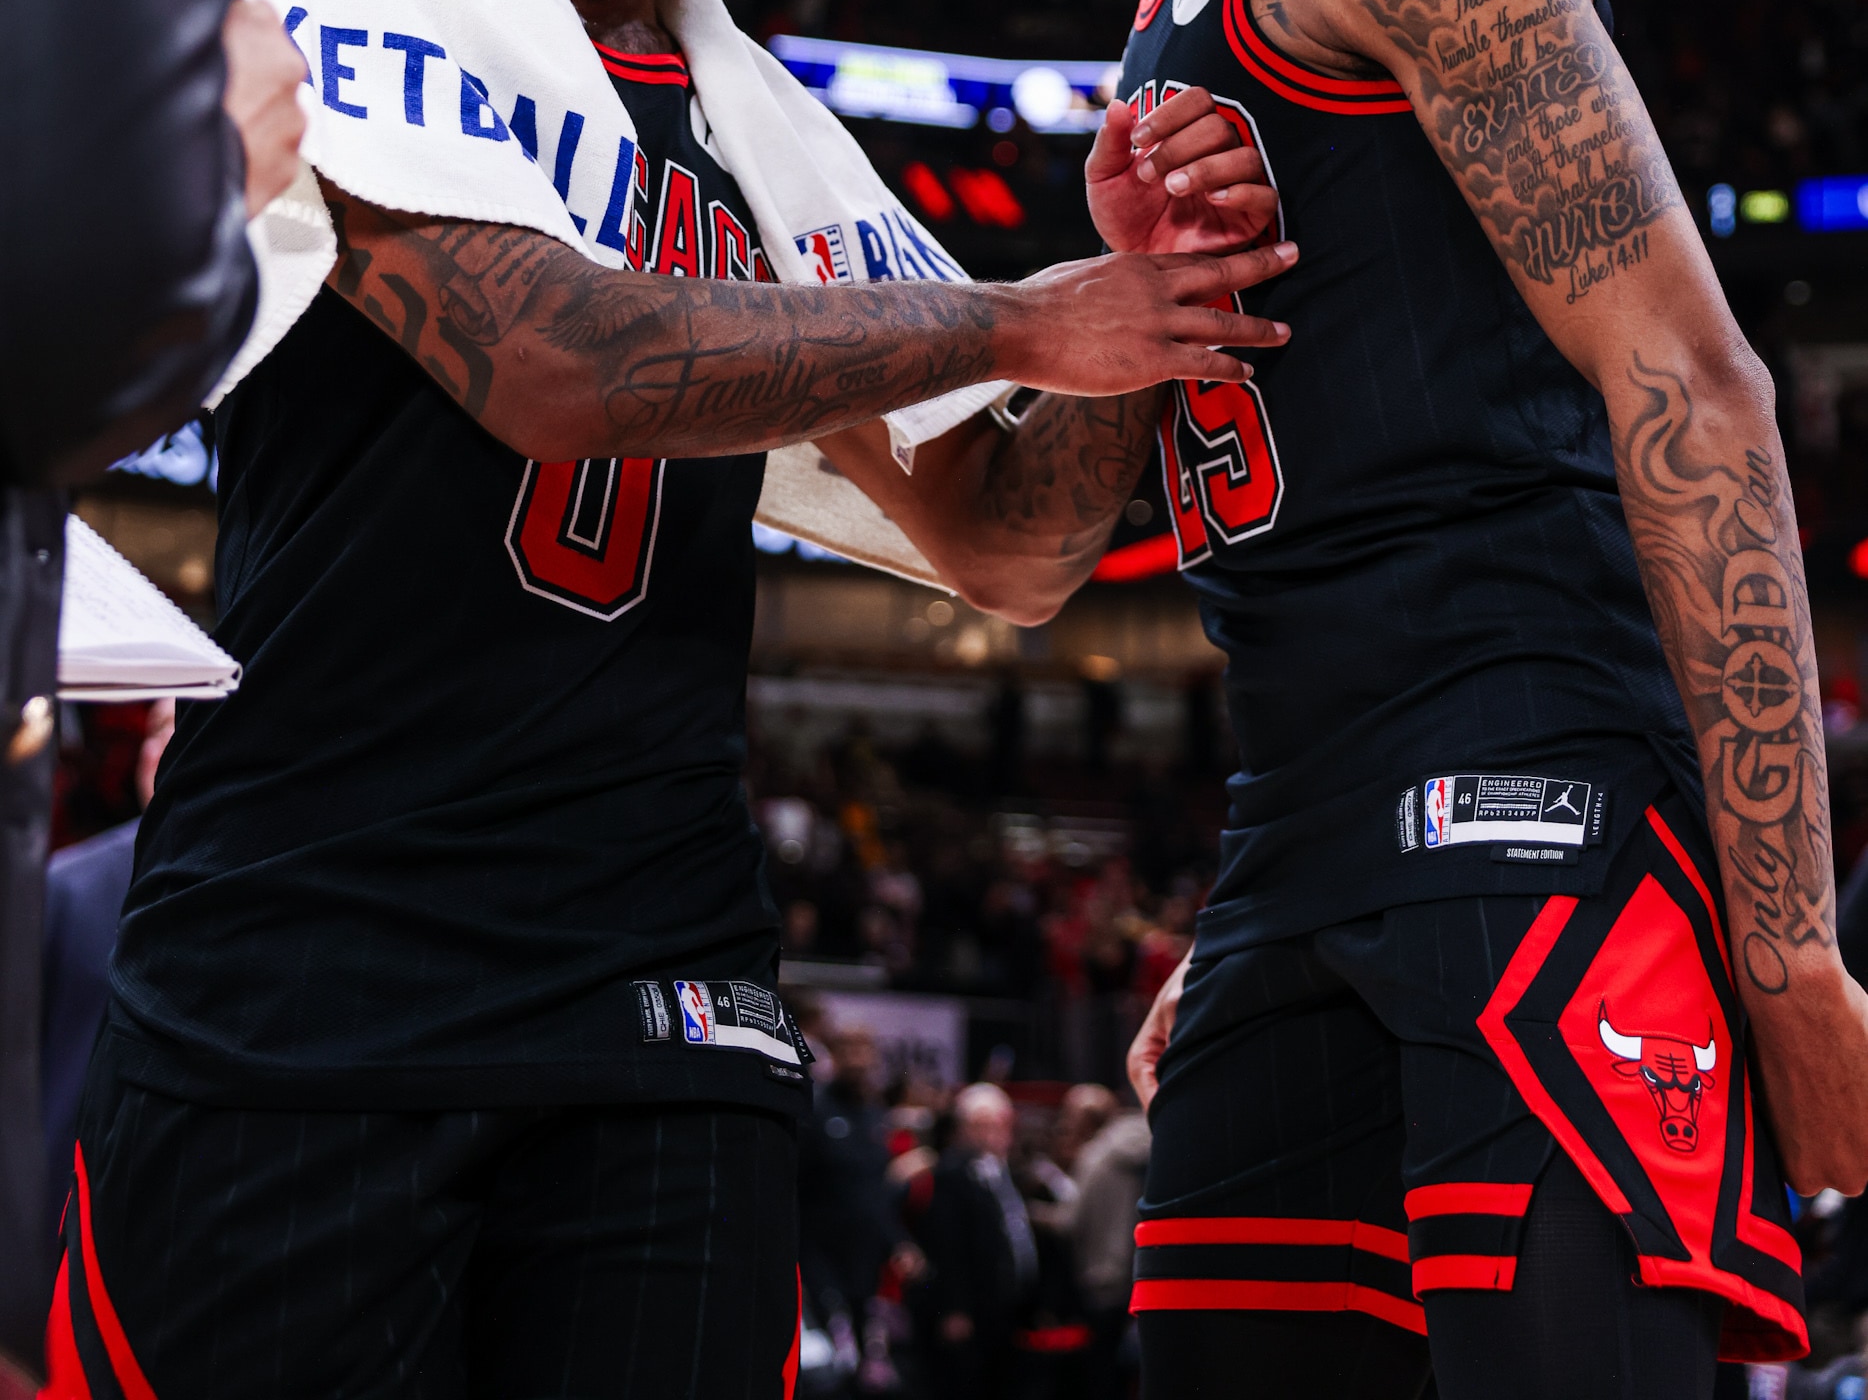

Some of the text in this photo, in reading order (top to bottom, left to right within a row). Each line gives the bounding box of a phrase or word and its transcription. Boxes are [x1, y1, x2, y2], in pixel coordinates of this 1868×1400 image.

[1435, 20, 1491, 73] humble
[1487, 30, 1558, 88] shall be
[1462, 42, 1608, 153] EXALTED
[1506, 125, 1535, 165] and
[1534, 105, 1583, 141] those
[1512, 148, 1550, 199] exalt
[1554, 149, 1628, 209] shall be
[1566, 231, 1650, 305] Luke 14:11
[1720, 444, 1801, 995] Only GOD Can
[1457, 792, 1473, 805] 46
[1481, 779, 1543, 789] ENGINEERED
[1506, 848, 1564, 860] STATEMENT EDITION
[717, 995, 731, 1009] 46
